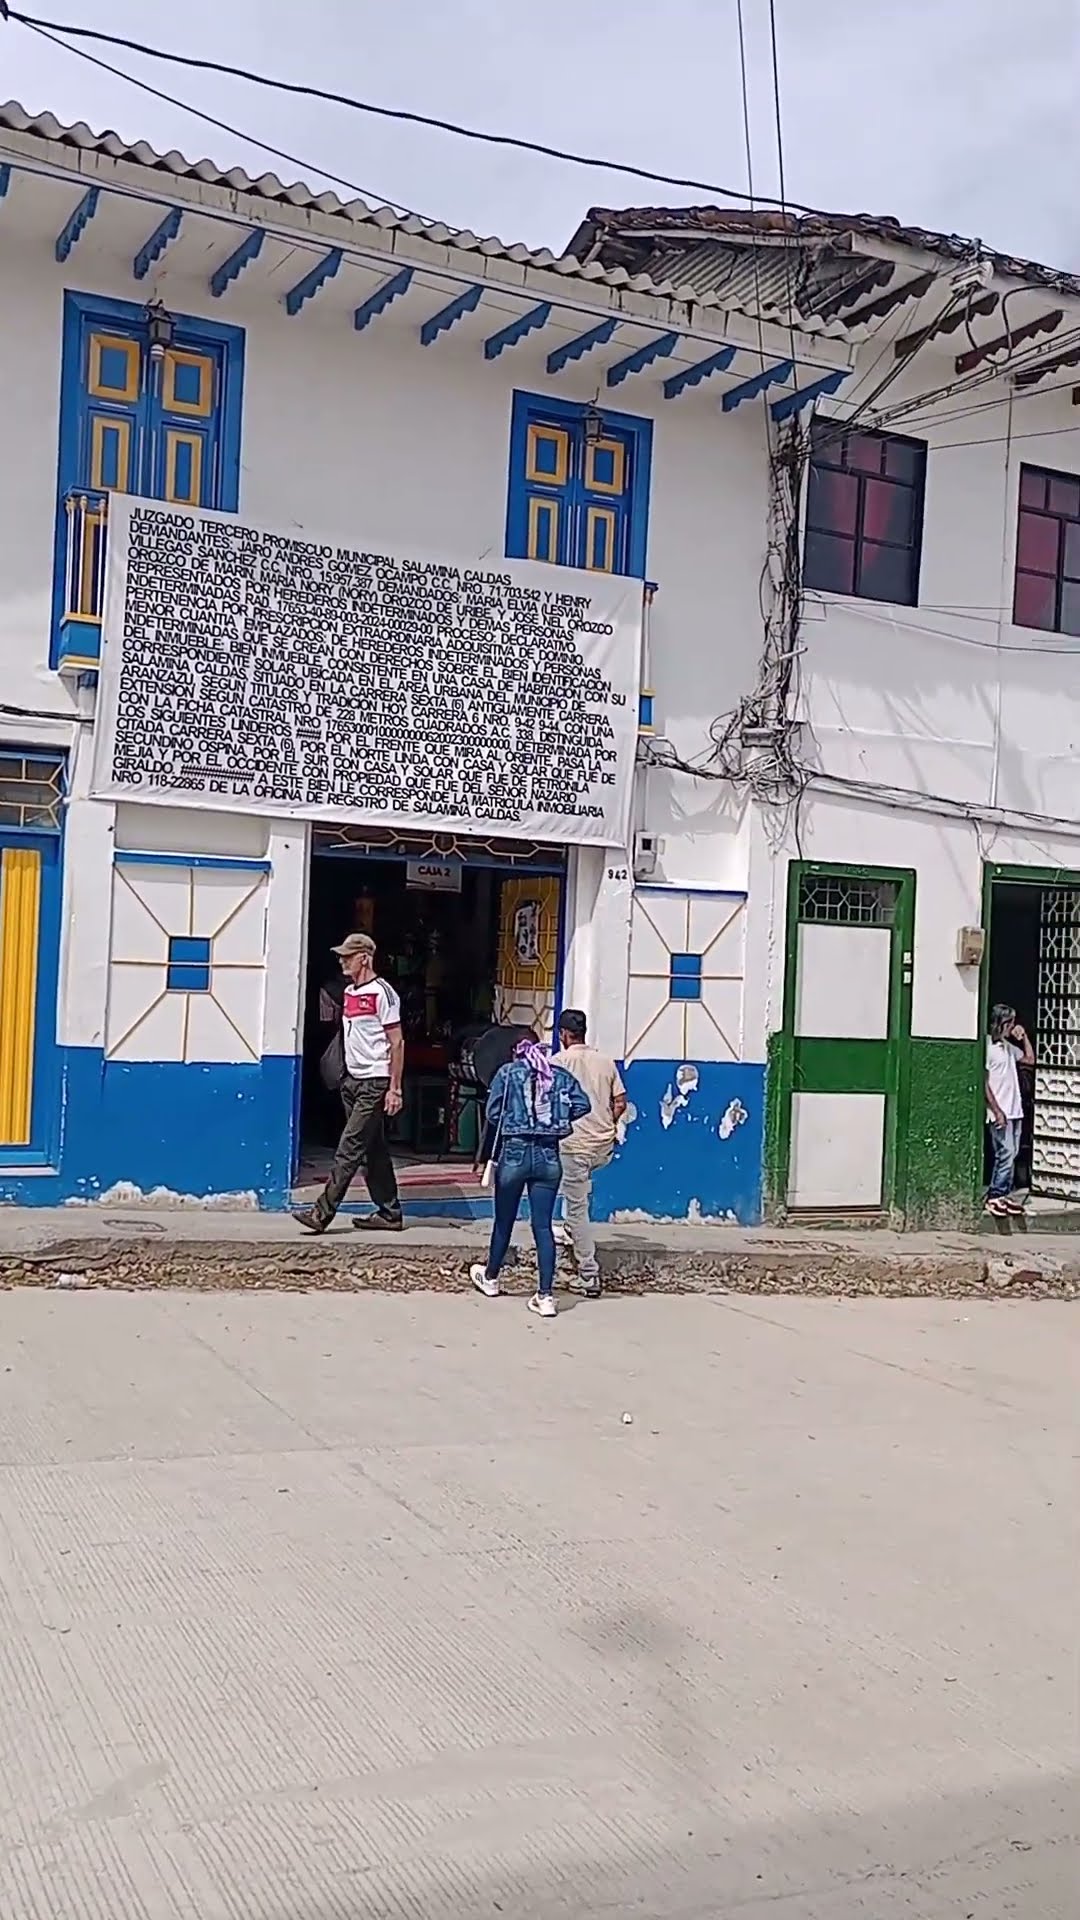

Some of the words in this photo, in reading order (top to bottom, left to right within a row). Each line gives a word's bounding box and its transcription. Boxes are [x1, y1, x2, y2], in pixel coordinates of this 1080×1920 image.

[128, 533, 193, 555] VILLEGAS
[197, 545, 257, 568] SANCHEZ
[465, 593, 503, 608] MARIA
[506, 598, 538, 613] ELVIA
[540, 602, 583, 619] (LESVIA)
[129, 507, 194, 529] JUZGADO
[198, 519, 259, 542] TERCERO
[262, 532, 332, 558] PROMISCUO
[336, 548, 398, 569] MUNICIPAL
[401, 559, 460, 579] SALAMINA
[463, 569, 511, 586] CALDAS
[236, 540, 272, 558] JAIRO
[274, 549, 324, 569] ANDRES
[327, 559, 372, 577] GOMEZ
[374, 567, 428, 586] OCAMPO
[555, 592, 592, 609] HENRY
[125, 585, 217, 611] PERTENENCIA
[252, 606, 338, 632] PRESCRIPCION
[342, 622, 443, 647] EXTRAORDINARIA
[445, 638, 515, 656] ADQUISITIVA
[126, 559, 241, 589] REPRESENTADOS
[244, 579, 271, 596] POR
[273, 585, 347, 609] HEREDEROS
[351, 600, 453, 625] INDETERMINADOS
[468, 617, 510, 633] DEMAS
[514, 622, 574, 641] PERSONAS
[126, 572, 240, 602] INDETERMINADAS
[500, 632, 576, 652] DECLARATIVO
[127, 546, 186, 567] OROZCO
[259, 570, 296, 589] MARIA
[299, 578, 334, 595] NORY
[337, 585, 378, 602] (NORY)
[381, 592, 432, 611] OROZCO
[508, 611, 539, 625] JOSE
[542, 614, 564, 628] NEL
[566, 618, 613, 635] OROZCO
[122, 624, 150, 640] DEL
[229, 640, 257, 656] BIEN
[327, 657, 407, 679] CONSISTENTE
[431, 671, 458, 685] UNA
[460, 675, 494, 689] CASA
[517, 681, 581, 699] HABITACION
[122, 638, 250, 667] CORRESPONDIENTE
[301, 665, 354, 684] UBICADA
[396, 680, 430, 694] AREA
[433, 684, 483, 700] URBANA
[513, 693, 568, 709] MUNICIPIO
[124, 598, 175, 617] MENOR
[179, 607, 236, 627] CUANTIA
[351, 636, 424, 657] HEREDEROS
[427, 648, 529, 669] INDETERMINADOS
[543, 661, 601, 679] PERSONAS
[124, 611, 239, 640] INDETERMINADAS
[241, 630, 268, 646] QUE
[292, 639, 334, 657] CREAN
[338, 646, 365, 661] CON
[369, 651, 433, 671] DERECHOS
[437, 660, 478, 676] SOBRE
[501, 667, 528, 682] BIEN
[531, 671, 611, 692] IDENTIFICACION
[119, 677, 195, 698] EXTENSION
[198, 687, 244, 705] SEGUN
[248, 694, 312, 714] CATASTRO
[335, 707, 355, 721] 228
[359, 710, 409, 727] METROS
[412, 717, 487, 735] CUADRADOS
[539, 730, 603, 748] DISTINGUIDA
[121, 650, 190, 672] SALAMINA
[252, 669, 305, 689] SITUADO
[349, 685, 407, 703] CARRERA
[410, 693, 448, 708] SEXTA
[450, 698, 464, 710] (6)
[467, 700, 555, 720] ANTIGUAMENTE
[558, 709, 610, 726] CARRERA
[200, 674, 246, 692] SEGUN
[249, 681, 298, 700] TITULOS
[315, 692, 377, 711] TRADICION
[381, 701, 407, 715] HOY
[410, 705, 468, 722] CARRERA
[514, 716, 535, 729] 9-42
[114, 729, 194, 750] SECUNDINO
[303, 752, 329, 767] SUR
[363, 759, 397, 774] CASA
[412, 765, 453, 779] SOLAR
[531, 776, 589, 793] PETRONILA
[115, 716, 164, 734] CITADA
[168, 723, 233, 742] CARRERA
[236, 731, 277, 747] SEXTA
[348, 746, 390, 762] NORTE
[394, 751, 429, 765] LINDA
[462, 758, 495, 772] CASA
[509, 762, 547, 777] SOLAR
[576, 769, 598, 783] FUE
[117, 703, 145, 718] LOS
[149, 707, 226, 728] SIGUIENTES
[230, 717, 292, 737] LINDEROS
[374, 736, 420, 753] FRENTE
[453, 745, 483, 759] MIRA
[556, 756, 585, 769] PASA
[176, 697, 215, 714] FICHA
[219, 703, 290, 724] CATASTRAL
[293, 713, 321, 728] NRO
[515, 740, 591, 758] DETERMINADA
[111, 769, 142, 784] NRO
[147, 773, 205, 791] 118-22865
[253, 784, 302, 801] OFICINA
[326, 792, 388, 809] REGISTRO
[412, 801, 471, 817] SALAMINA
[113, 742, 154, 759] MEJIA
[171, 749, 201, 764] POR
[226, 755, 297, 775] OCCIDENTE
[301, 764, 329, 779] CON
[332, 768, 401, 786] PROPIEDAD
[405, 776, 431, 790] QUE
[434, 778, 458, 792] FUE
[461, 781, 485, 795] DEL
[530, 788, 577, 803] NAZARIO
[271, 773, 303, 789] ESTE
[307, 777, 335, 792] BIEN
[358, 783, 449, 803] CORRESPONDE
[470, 794, 534, 811] MATRICULA
[536, 800, 604, 817] INMOBILIARIA
[608, 869, 627, 880] 942
